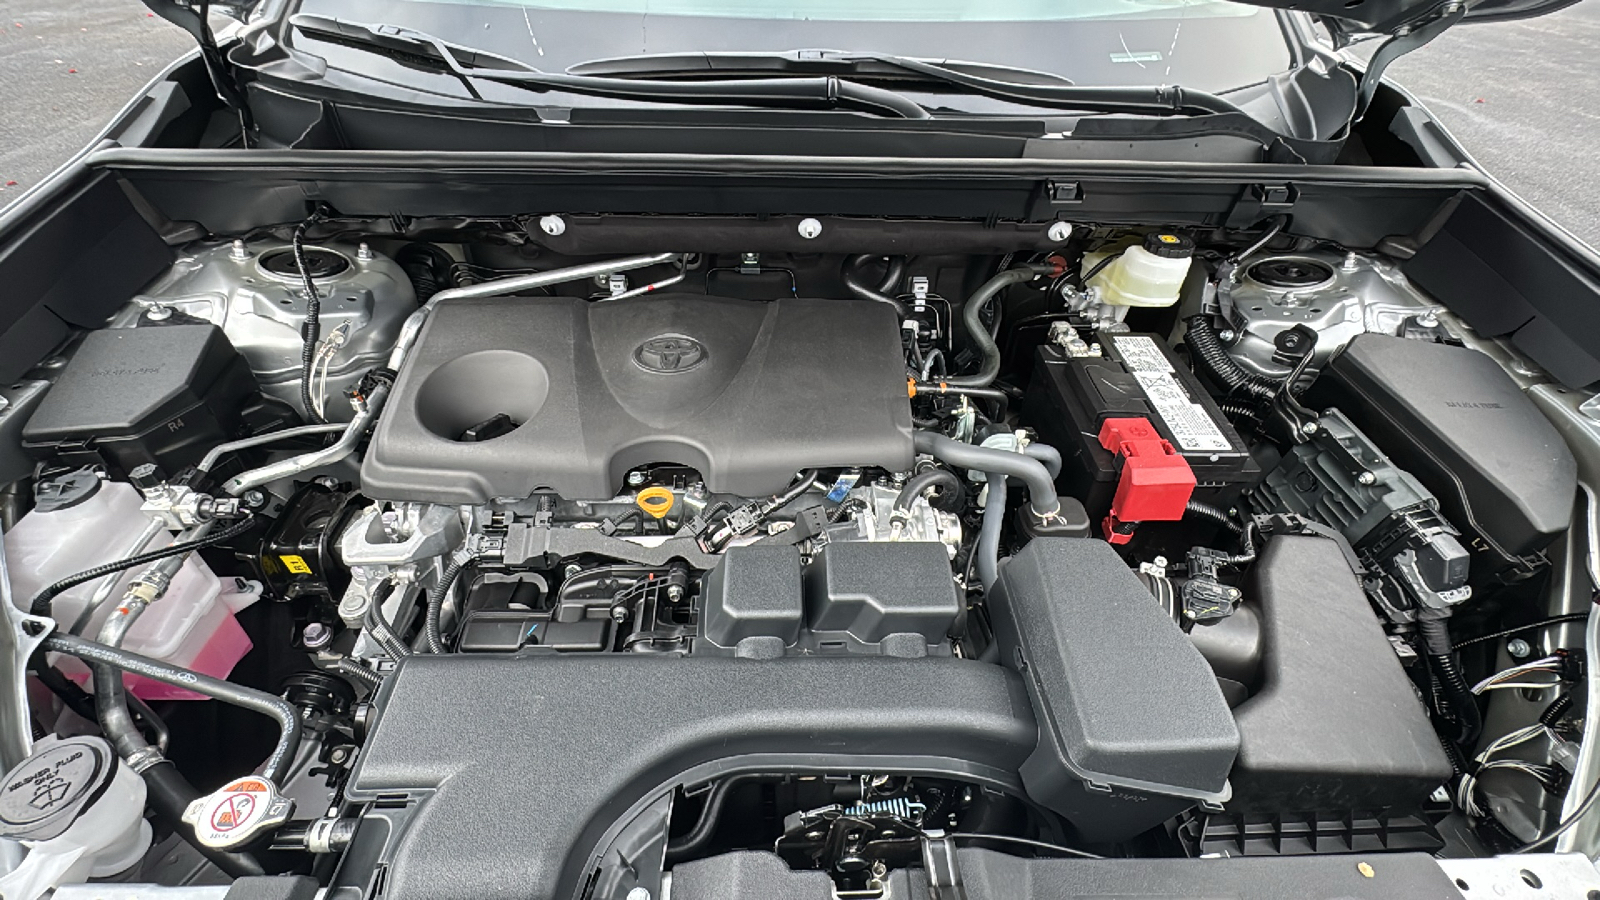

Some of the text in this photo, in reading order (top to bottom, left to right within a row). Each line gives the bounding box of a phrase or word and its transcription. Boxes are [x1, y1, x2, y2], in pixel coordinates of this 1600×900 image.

[168, 418, 184, 433] R4
[1471, 537, 1489, 551] L7
[34, 768, 59, 785] ONLY
